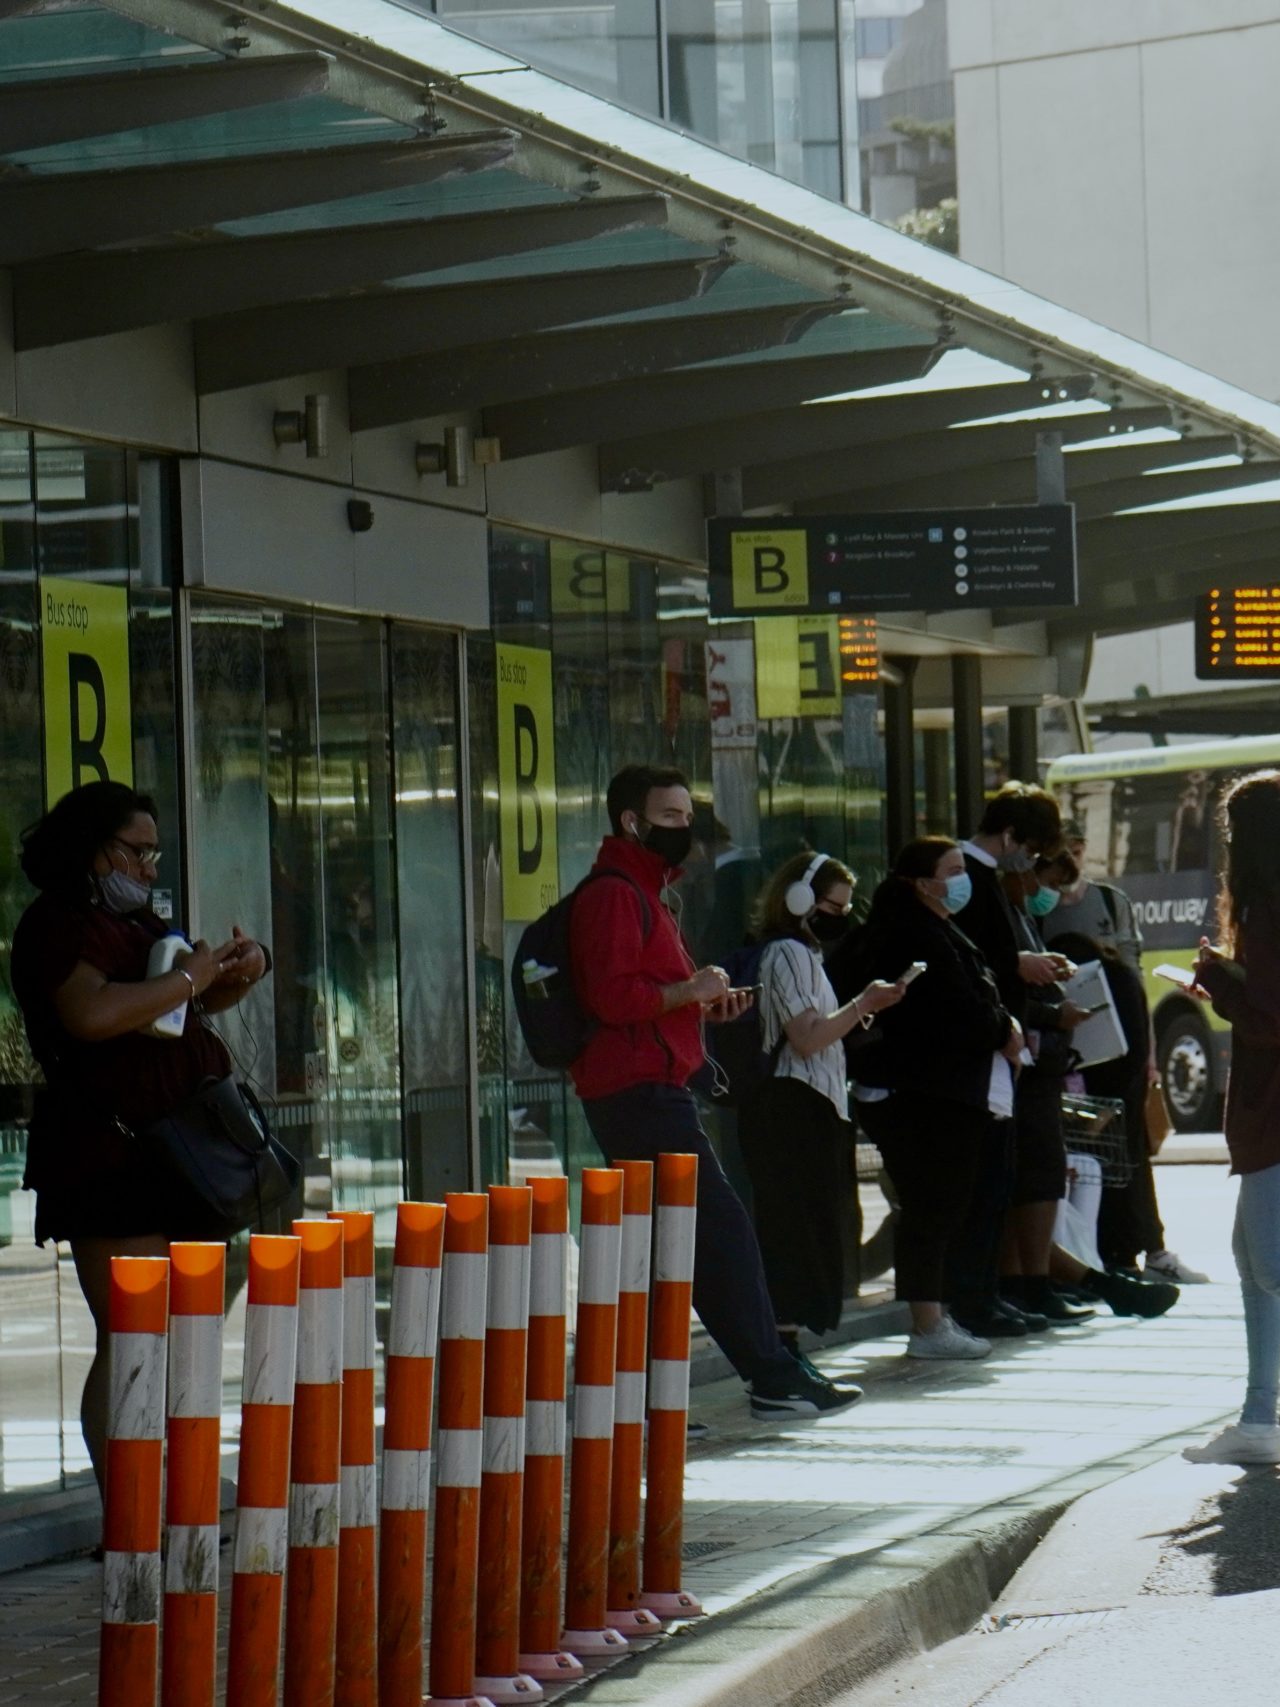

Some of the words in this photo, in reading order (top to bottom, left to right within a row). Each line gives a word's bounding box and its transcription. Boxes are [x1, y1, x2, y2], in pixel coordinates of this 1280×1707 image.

[753, 546, 790, 595] B
[47, 592, 65, 627] Bus
[67, 603, 88, 635] stop
[500, 656, 512, 683] Bus
[513, 660, 527, 690] stop
[514, 703, 543, 874] B
[1145, 900, 1172, 924] our
[1173, 897, 1208, 926] way
